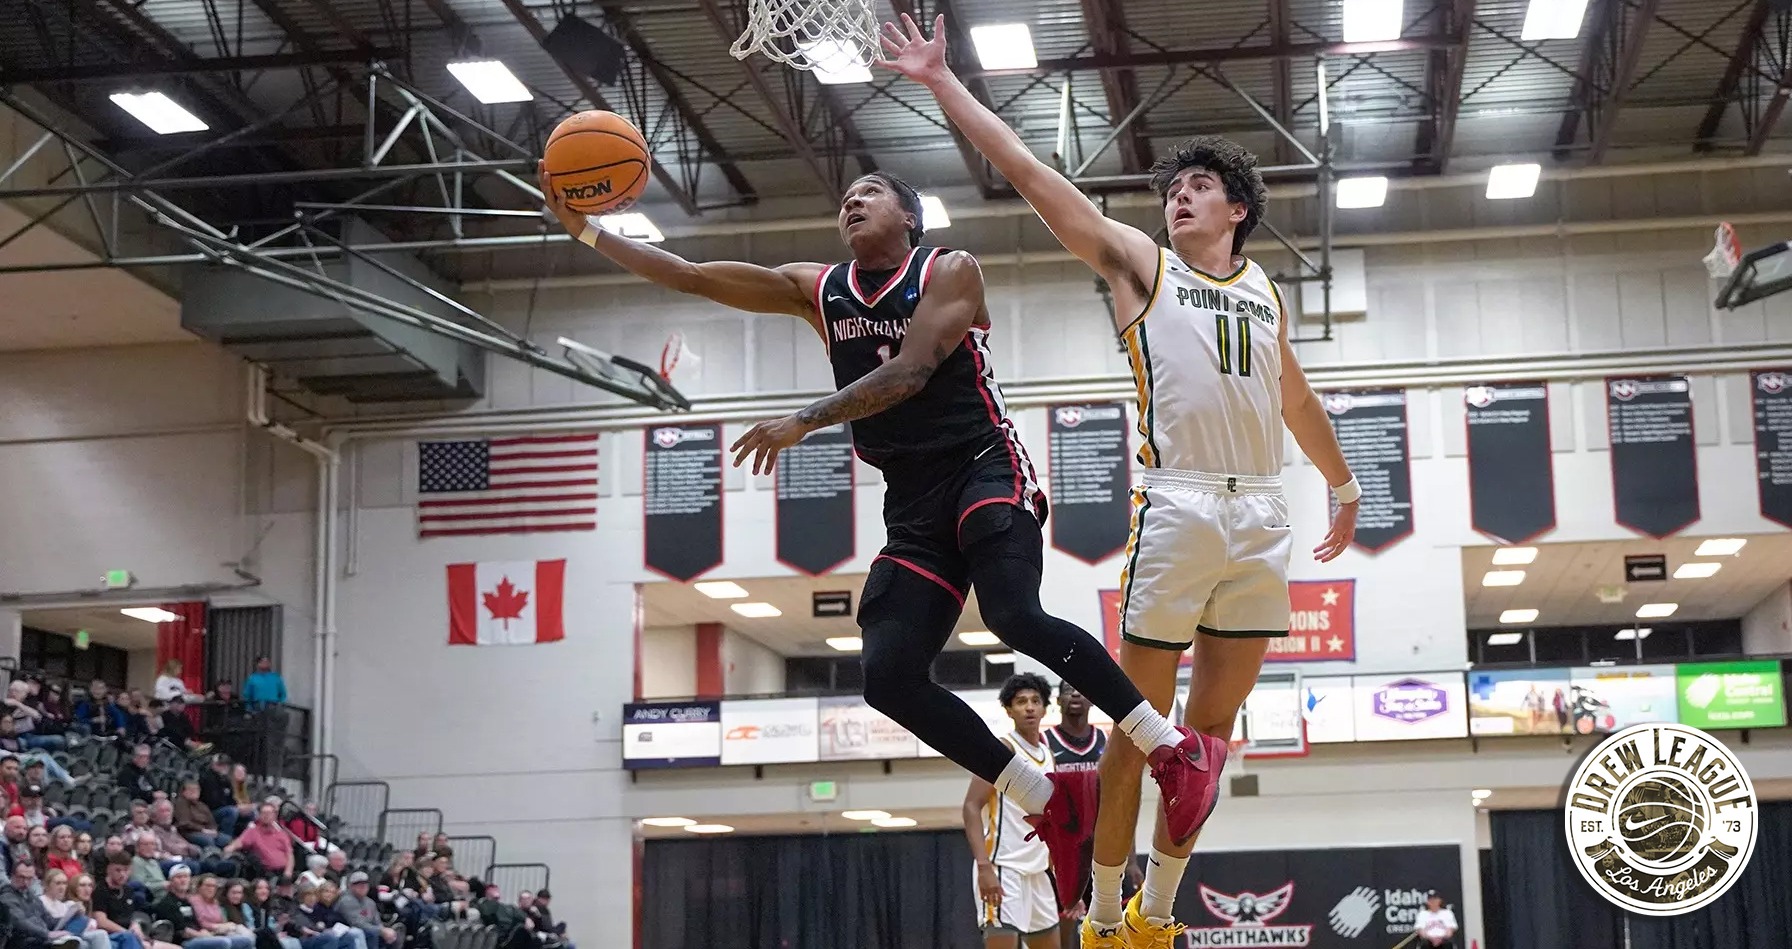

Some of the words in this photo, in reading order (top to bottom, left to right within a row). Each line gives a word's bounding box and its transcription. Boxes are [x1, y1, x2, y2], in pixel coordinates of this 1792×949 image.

[562, 179, 612, 199] NCAA
[1176, 286, 1229, 312] POINT
[833, 316, 911, 342] NIGHTHAW
[1215, 314, 1252, 377] 11
[634, 708, 669, 721] ANDY
[1056, 762, 1099, 773] NIGHTHAW
[1191, 929, 1306, 945] NIGHTHAWKS
